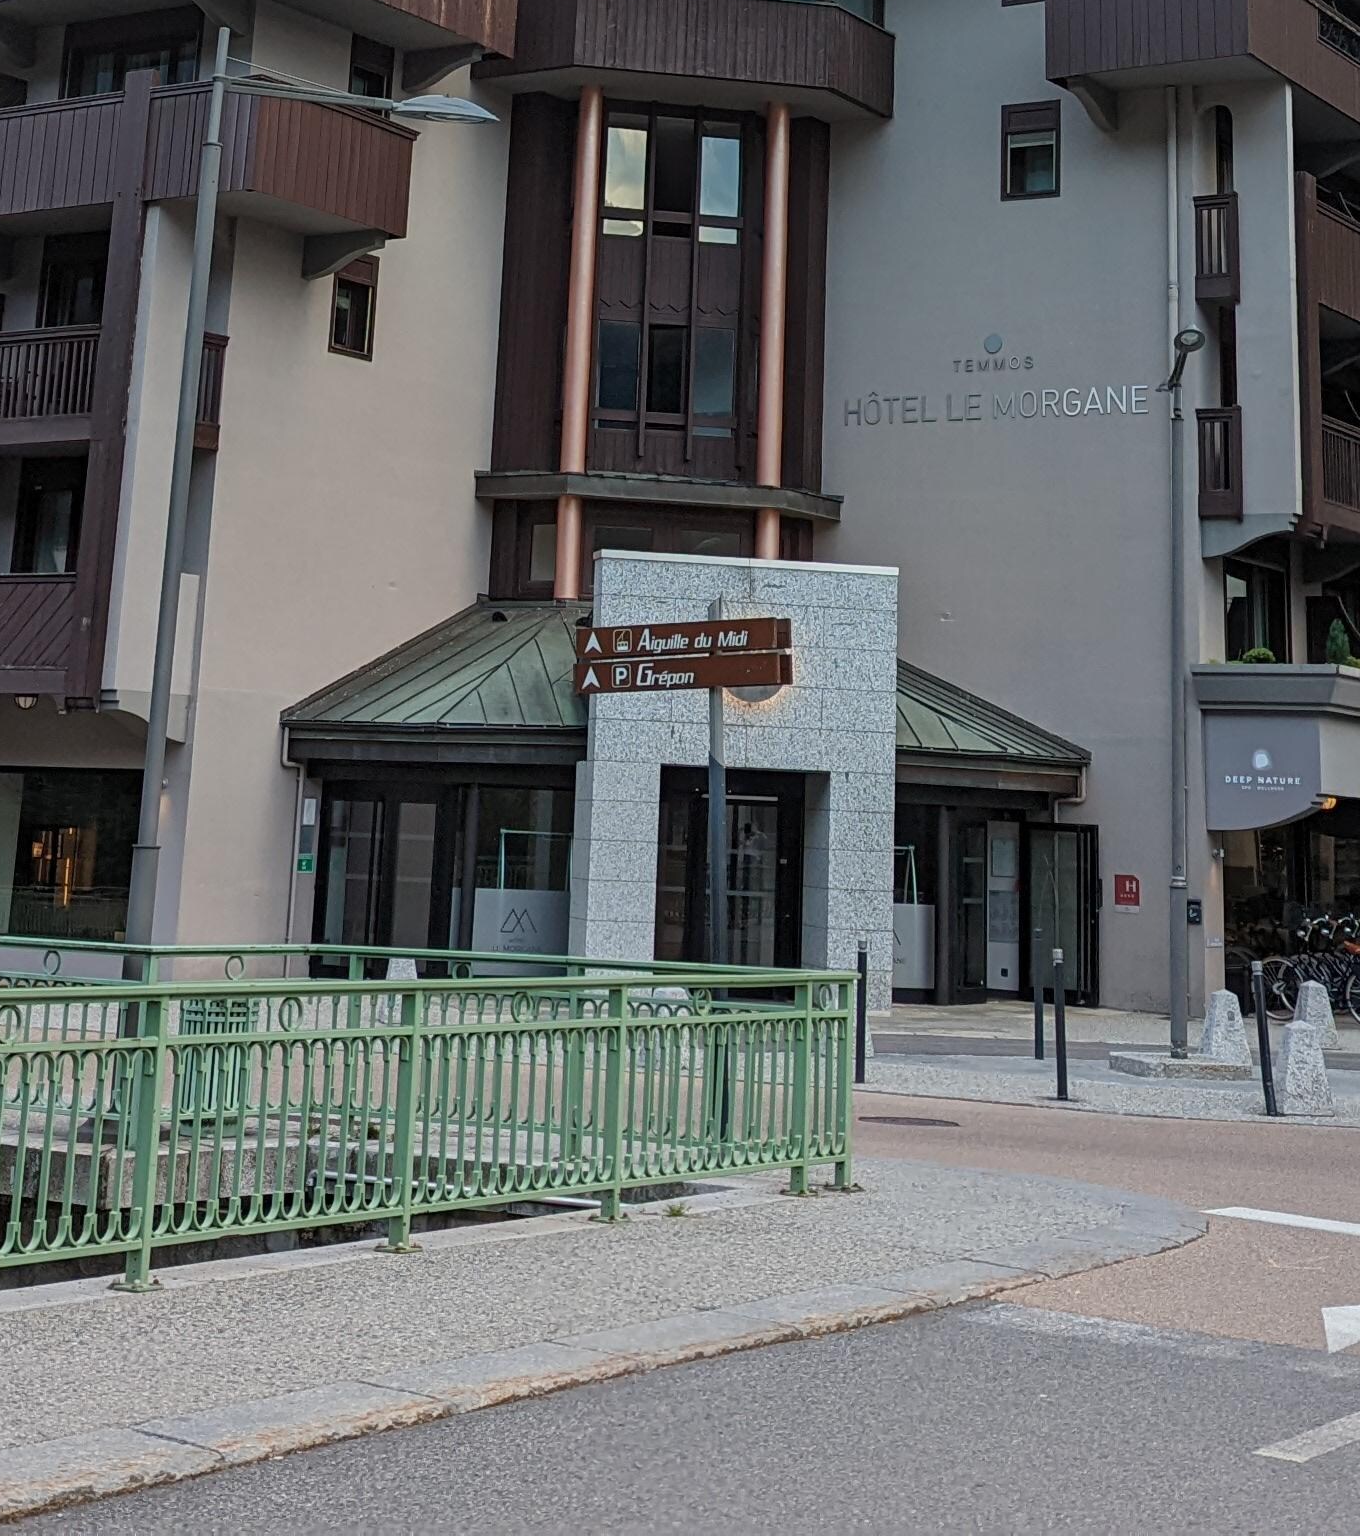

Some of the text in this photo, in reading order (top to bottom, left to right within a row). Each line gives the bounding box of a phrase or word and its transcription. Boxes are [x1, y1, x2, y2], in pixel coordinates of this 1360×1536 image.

[953, 356, 1035, 373] TEMMOS
[843, 385, 1149, 426] HÔTEL LE MORGANE
[637, 628, 748, 654] Aiguille du Midi
[636, 663, 695, 689] Grépon
[1225, 775, 1301, 785] DEEP NATURE
[1125, 880, 1137, 892] H
